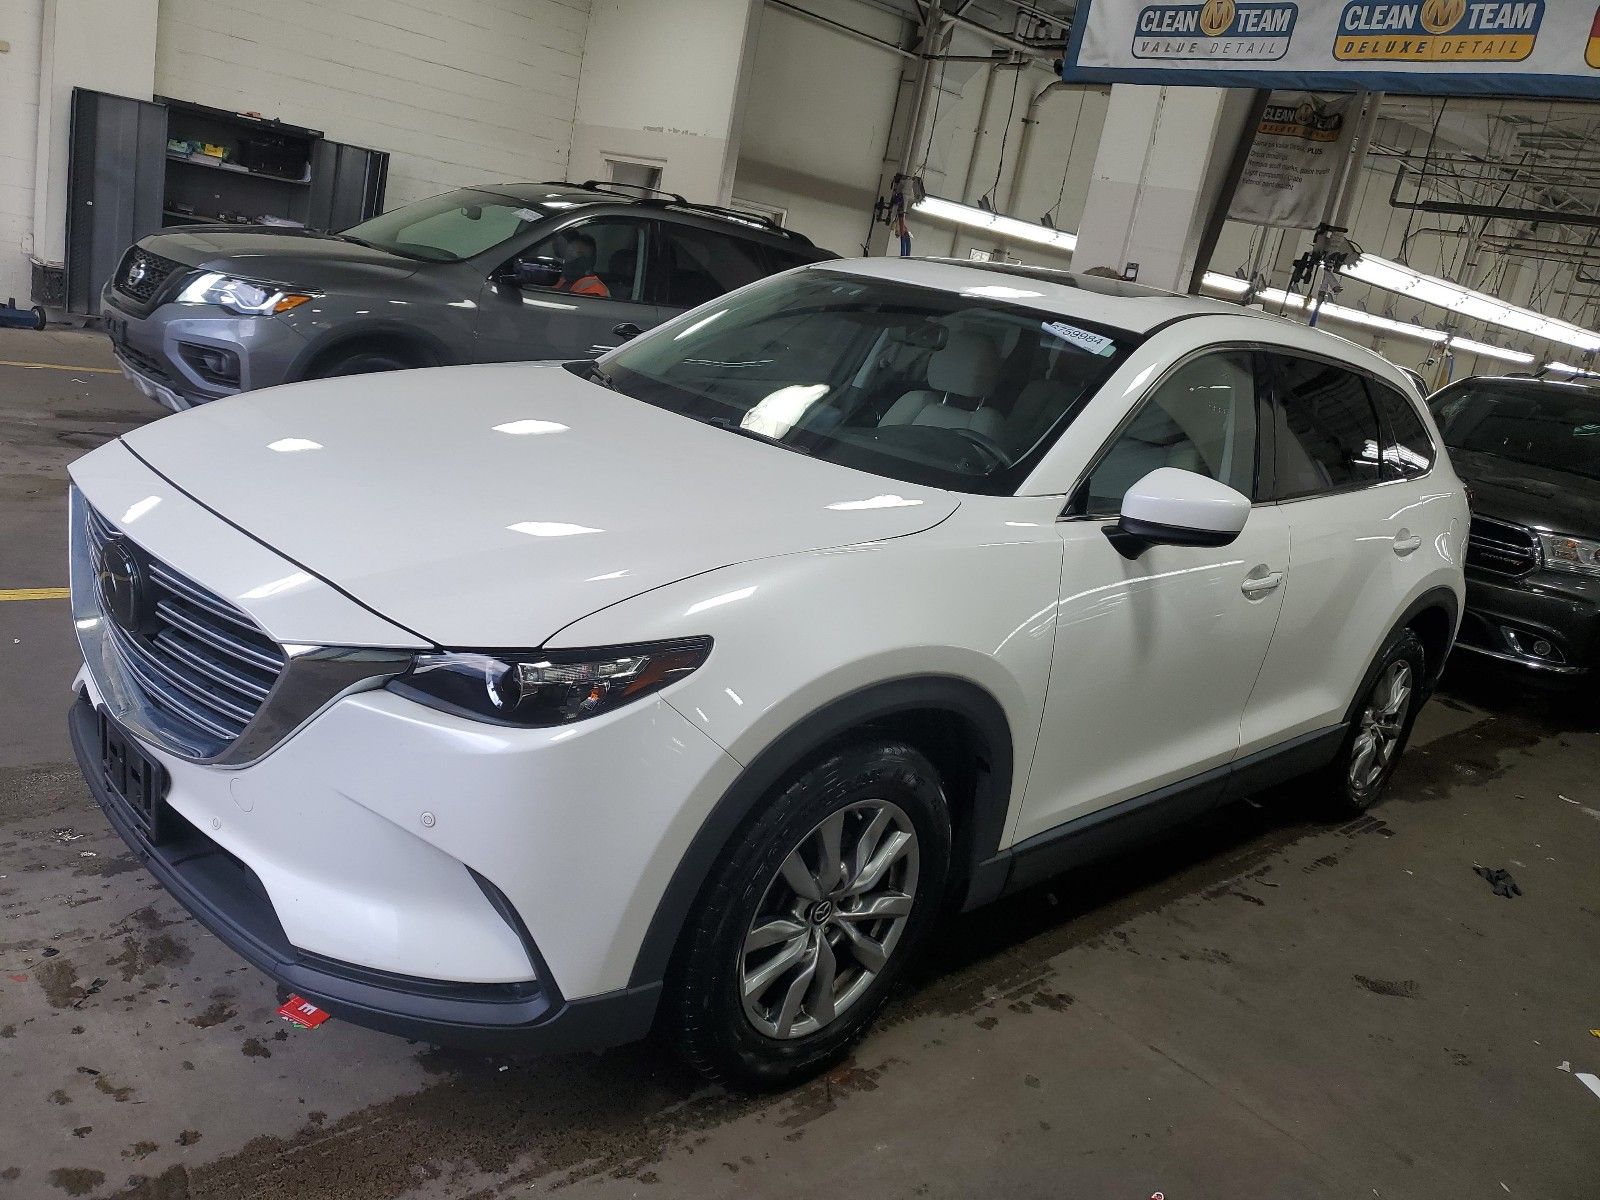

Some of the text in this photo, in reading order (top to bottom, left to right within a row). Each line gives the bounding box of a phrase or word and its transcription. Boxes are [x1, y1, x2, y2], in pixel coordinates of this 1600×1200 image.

[1140, 9, 1199, 33] CLEAN
[1237, 8, 1294, 33] TEAM
[1344, 4, 1418, 31] CLEAN
[1468, 2, 1538, 30] TEAM
[1141, 41, 1277, 54] VALUE DETAIL
[1343, 40, 1520, 55] DELUXE DETAIL
[1263, 107, 1296, 122] CLEAN
[1306, 147, 1323, 155] PLUS
